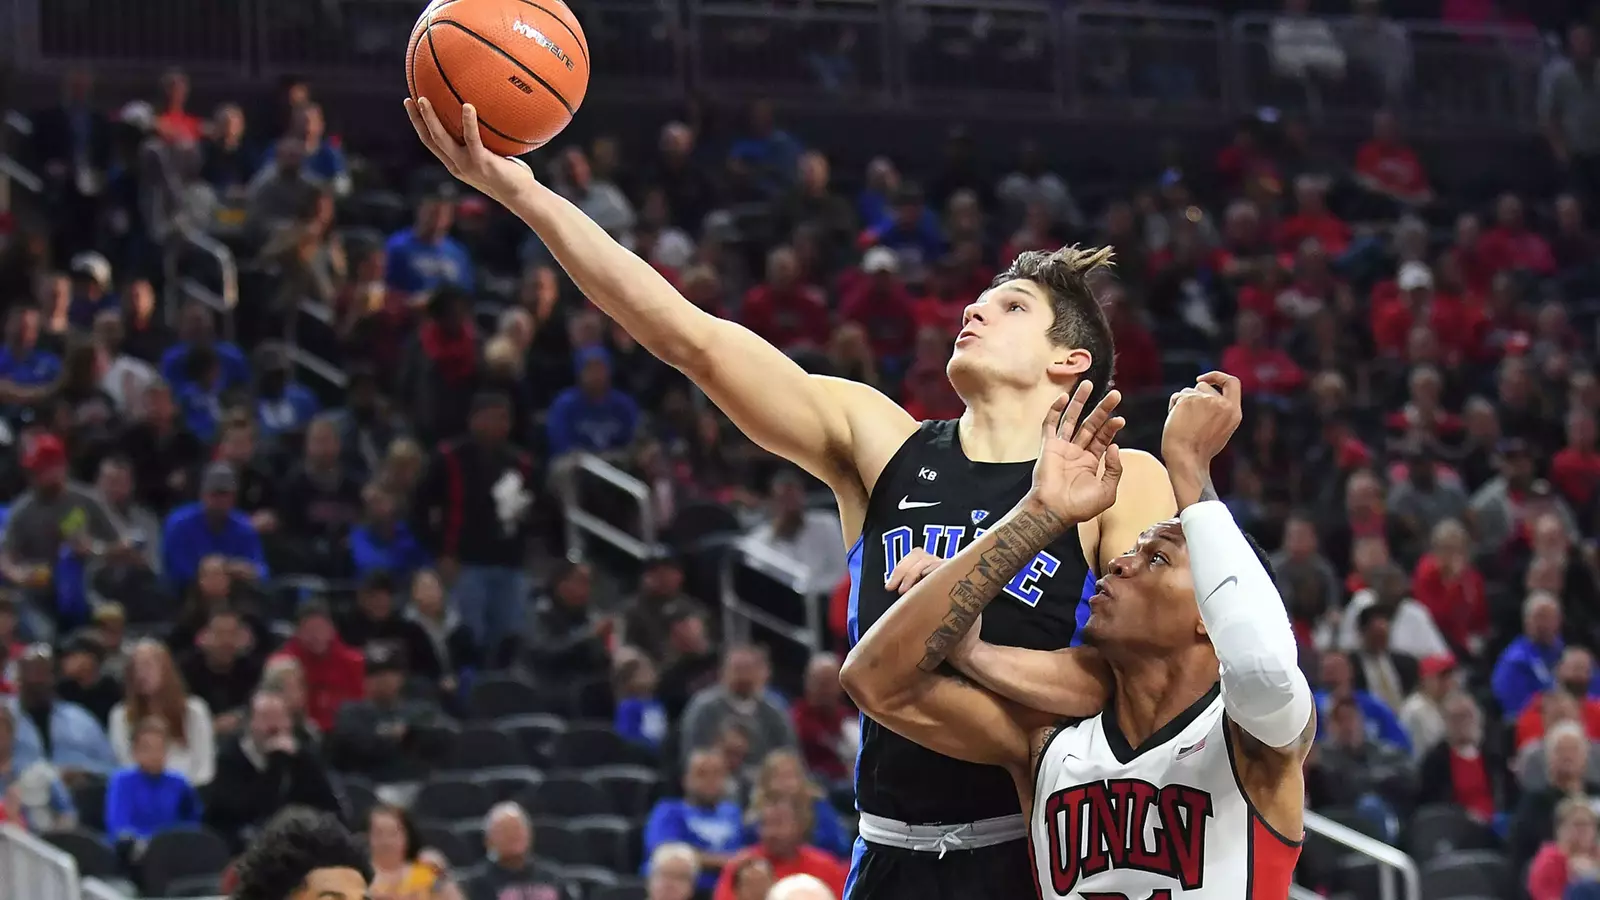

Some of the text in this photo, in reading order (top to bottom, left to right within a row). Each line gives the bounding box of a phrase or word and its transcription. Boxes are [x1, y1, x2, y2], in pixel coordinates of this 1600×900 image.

[918, 466, 937, 481] KB
[882, 524, 1061, 608] DUE
[1045, 778, 1214, 896] UNLV
